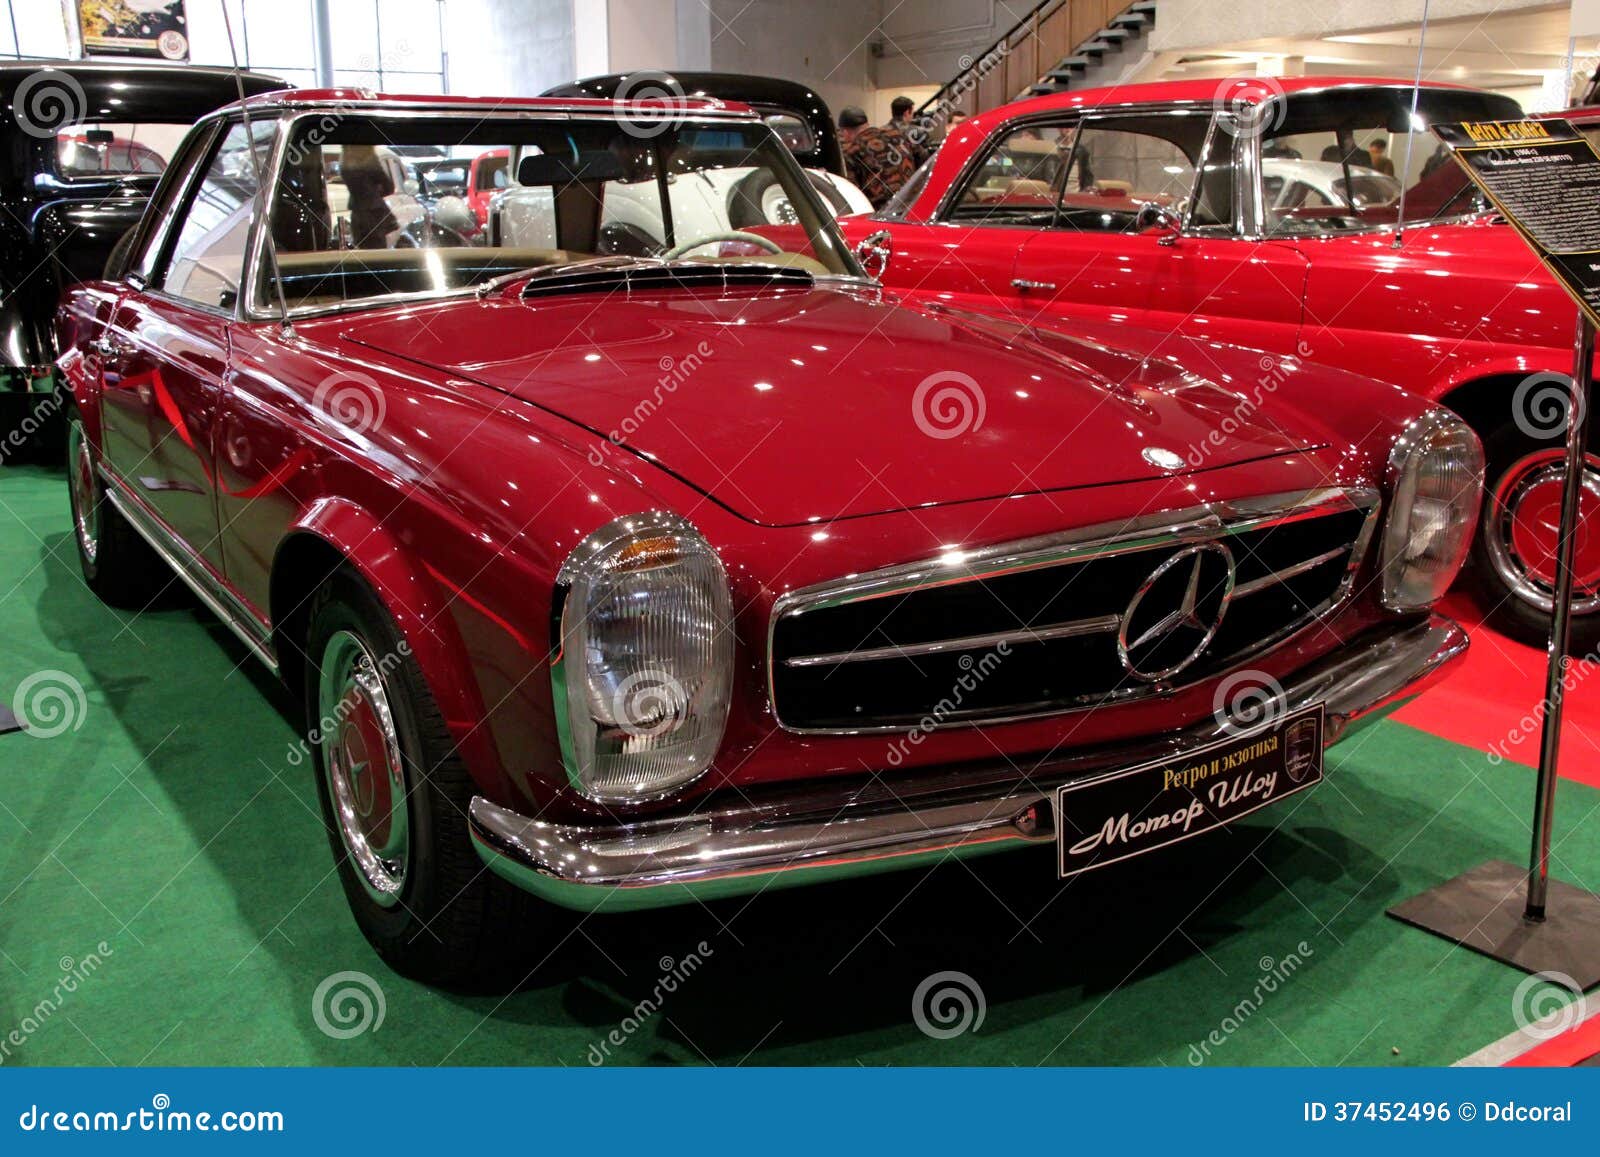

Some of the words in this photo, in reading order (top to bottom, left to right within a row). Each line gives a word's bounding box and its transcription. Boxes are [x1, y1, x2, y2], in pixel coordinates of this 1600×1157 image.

[1460, 121, 1501, 141] Retro
[1163, 764, 1208, 791] Ретро
[1210, 760, 1219, 776] и
[1222, 734, 1278, 770] экзотика
[1068, 797, 1204, 854] Мотор
[1208, 770, 1278, 808] Шоу
